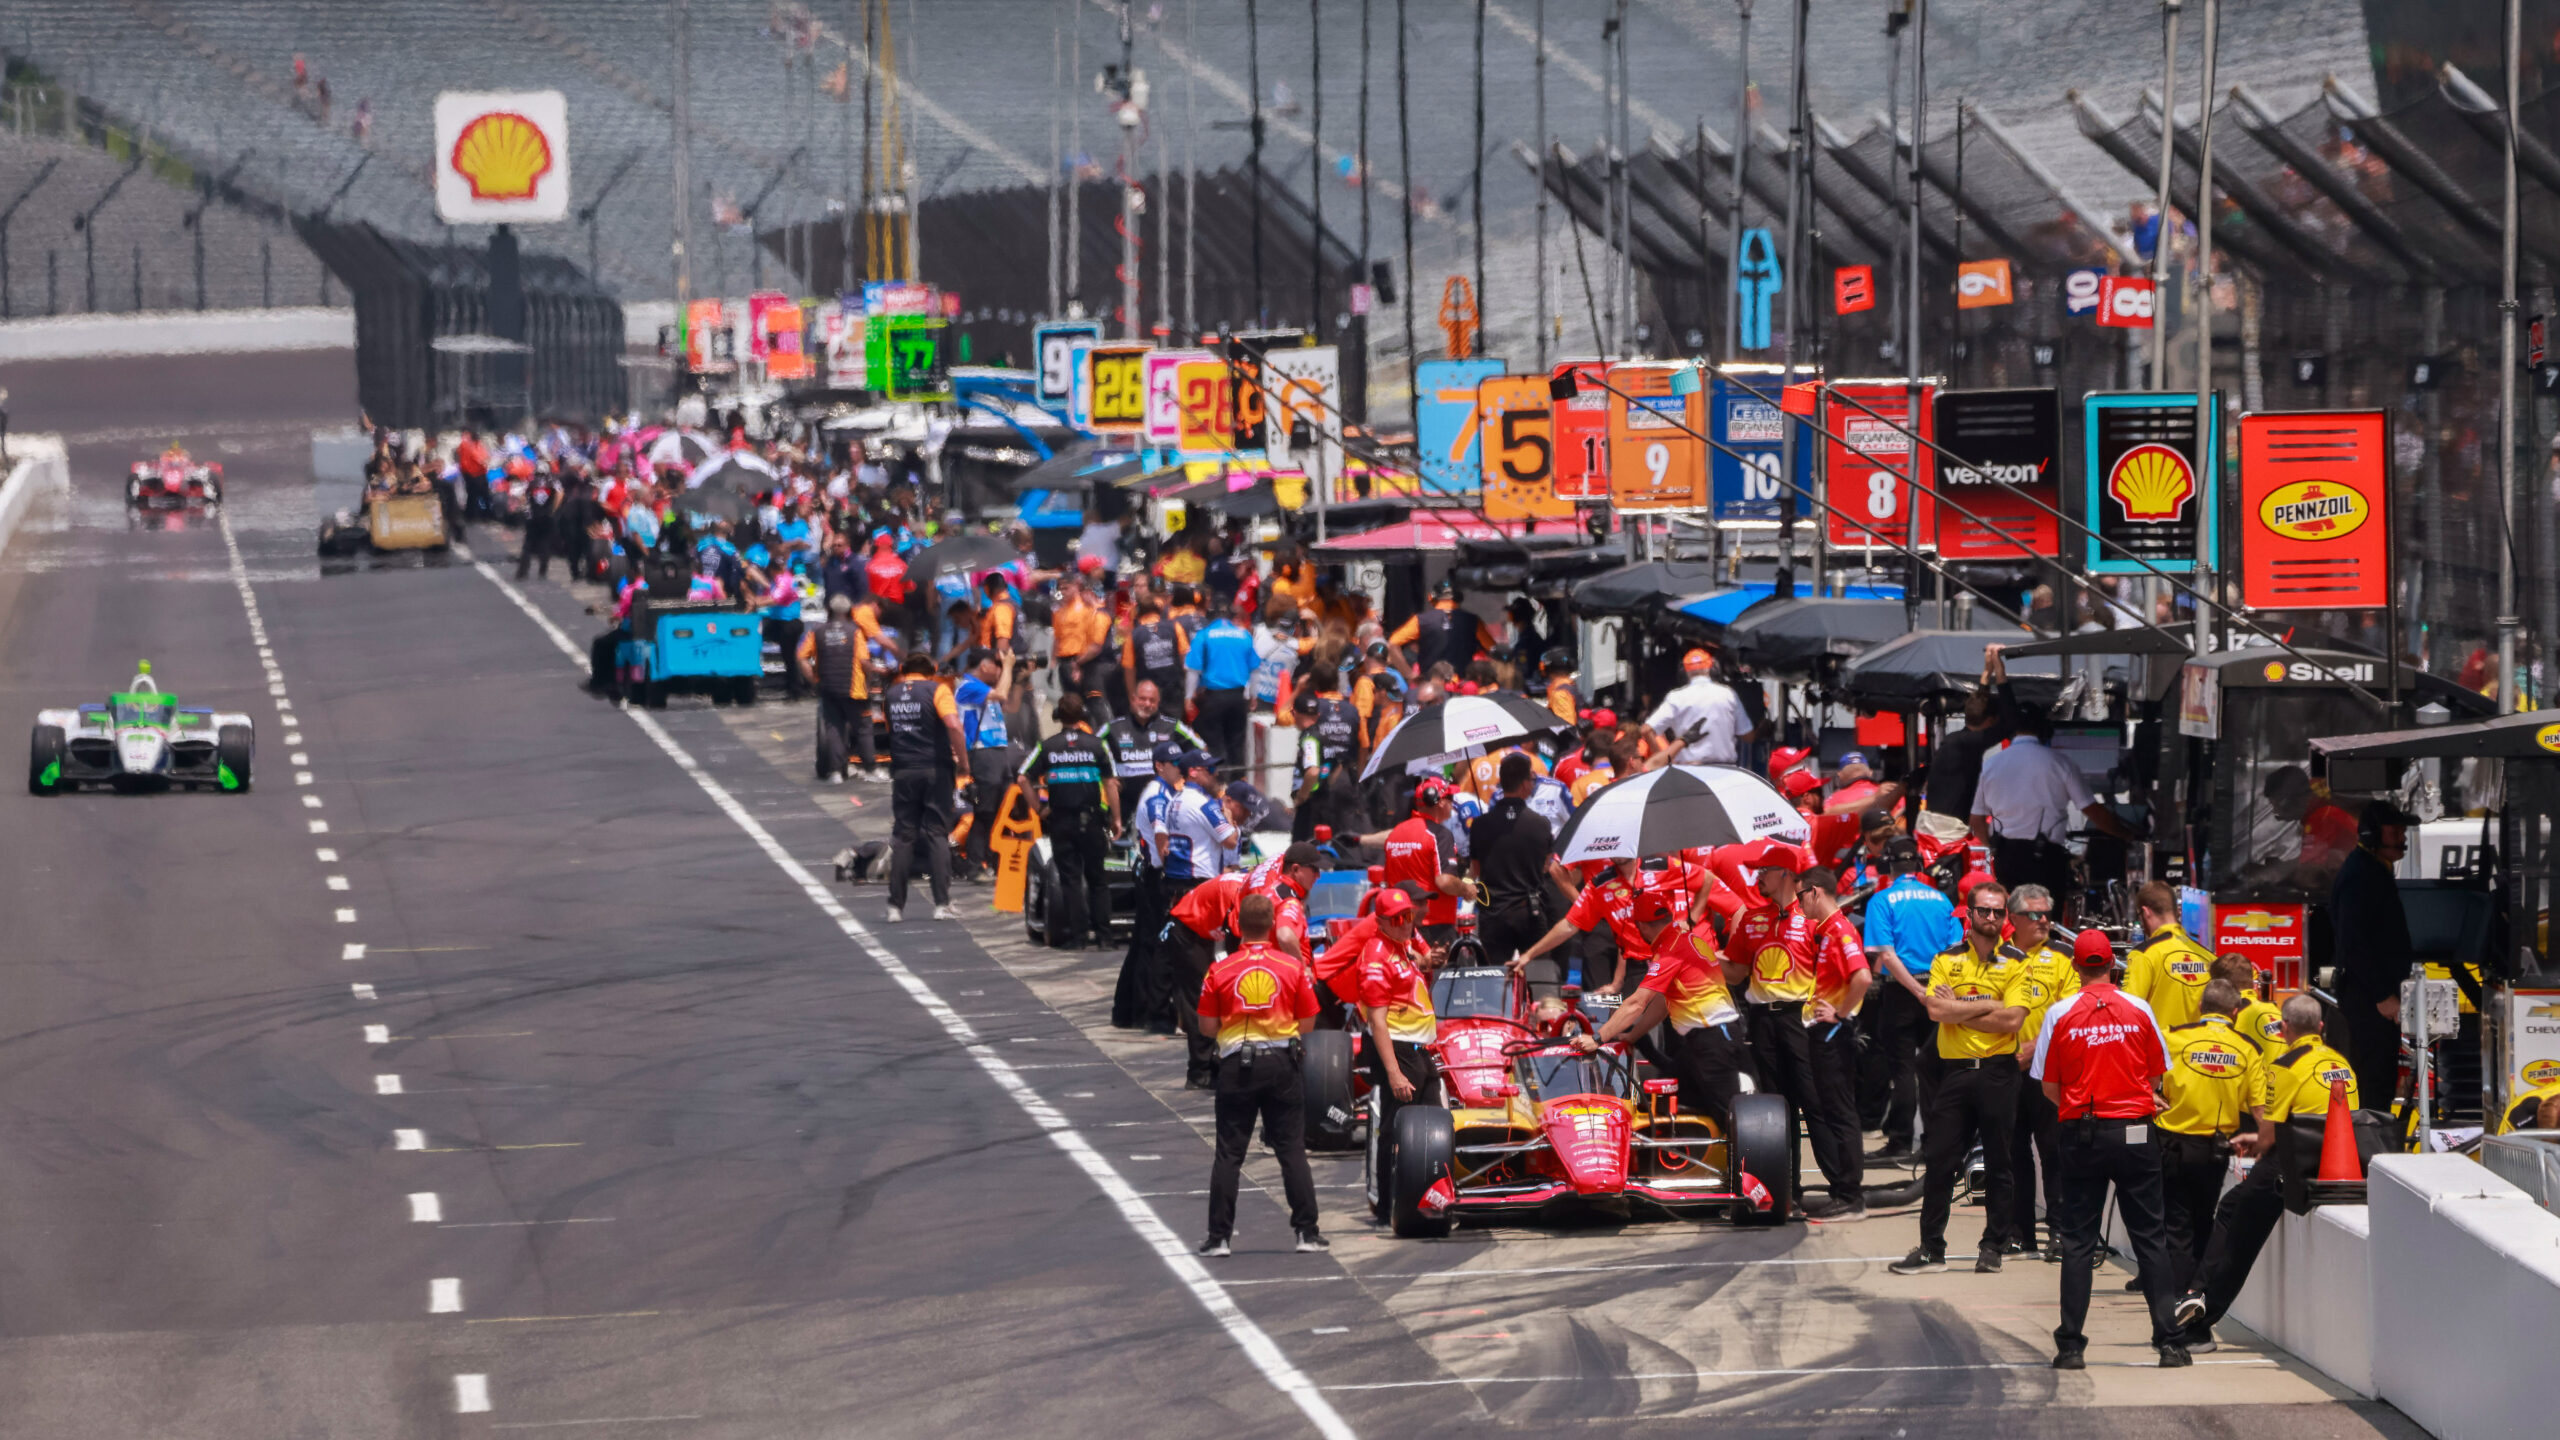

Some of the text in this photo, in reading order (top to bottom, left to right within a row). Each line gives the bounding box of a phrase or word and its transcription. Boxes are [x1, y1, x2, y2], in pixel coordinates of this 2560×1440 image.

[2067, 270, 2100, 313] 10
[2113, 287, 2155, 318] 8
[899, 340, 936, 370] 77
[1437, 390, 1477, 462] 7
[1501, 409, 1549, 482] 5
[1645, 443, 1670, 485] 9
[1944, 460, 2039, 484] verizon
[1740, 452, 1781, 500] 10
[1867, 471, 1897, 519] 8
[2274, 495, 2353, 525] PENNZOIL
[2289, 663, 2374, 682] Shell
[1048, 751, 1095, 764] Deloitte
[1121, 749, 1153, 762] Deloit
[1753, 812, 1776, 823] TEAM
[1753, 818, 1784, 832] PENSKE
[1585, 843, 1621, 853] PENSKE
[1593, 836, 1620, 844] TEAM
[1888, 889, 1944, 904] OFFICIAL
[2220, 936, 2297, 946] CHEVROLET
[2171, 962, 2207, 974] PENNZOIL
[2069, 1023, 2139, 1041] Firestone
[2086, 1032, 2125, 1048] Racing
[1453, 1033, 1505, 1051] 12
[2190, 1053, 2238, 1066] PENNZOIL
